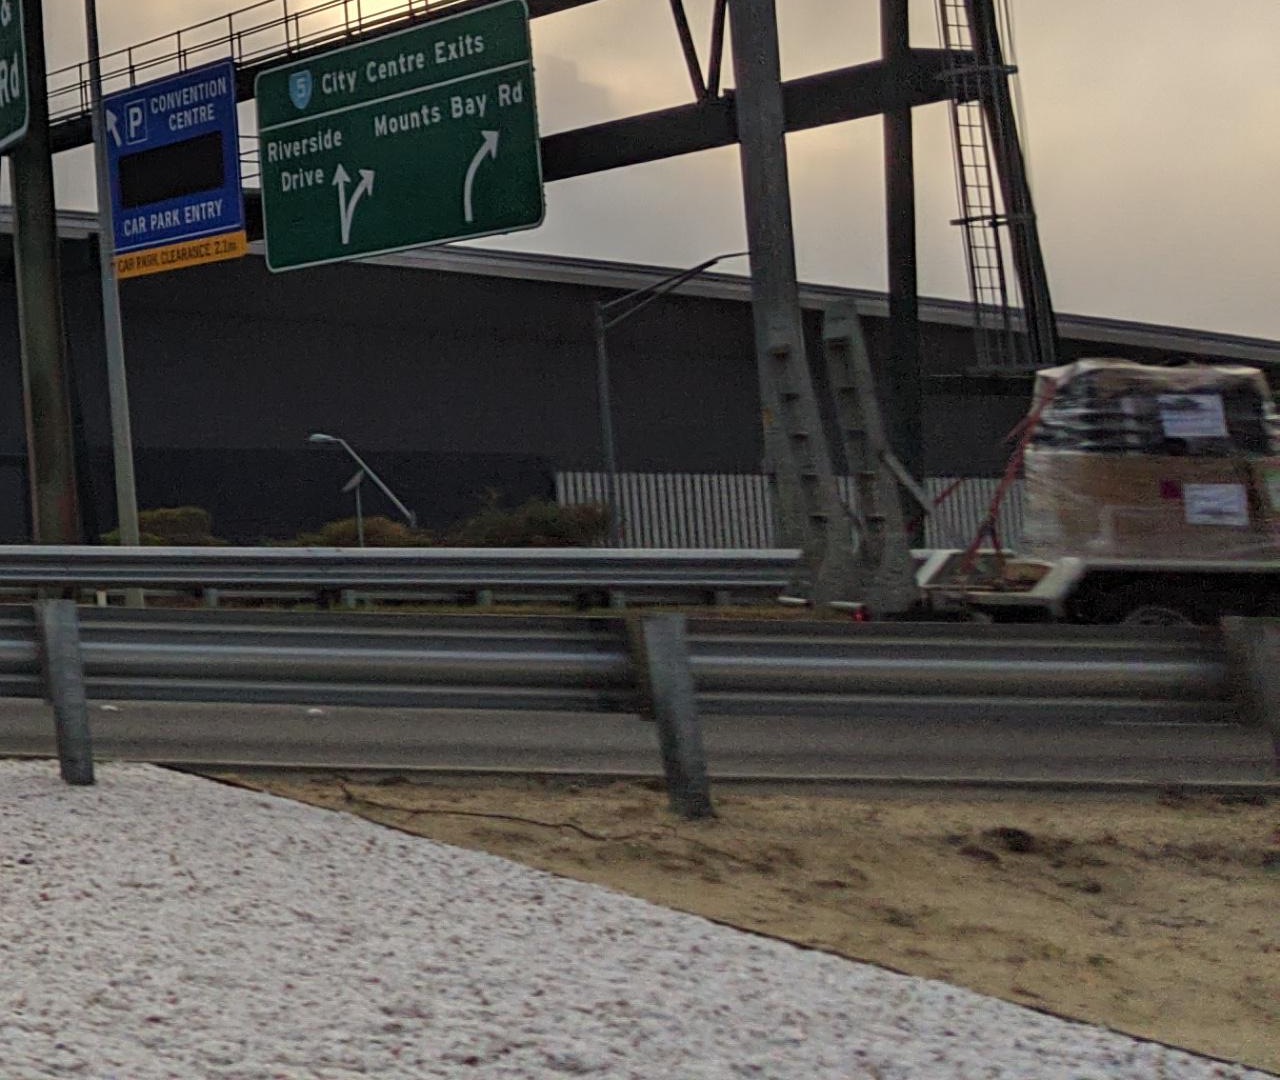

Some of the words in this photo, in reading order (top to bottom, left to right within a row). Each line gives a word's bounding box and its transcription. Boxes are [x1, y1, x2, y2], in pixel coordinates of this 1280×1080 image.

[321, 70, 357, 97] City
[366, 51, 425, 84] Centre
[434, 31, 485, 65] Exits
[150, 76, 227, 115] CONVENTION
[373, 102, 442, 138] Mounts
[450, 92, 488, 120] Bay
[497, 80, 524, 107] Rd
[167, 104, 216, 133] CENTRE
[266, 128, 343, 164] Riverside
[280, 167, 326, 193] Drive
[123, 214, 147, 237] CAR
[149, 205, 183, 231] PARK
[184, 198, 224, 223] ENTRY
